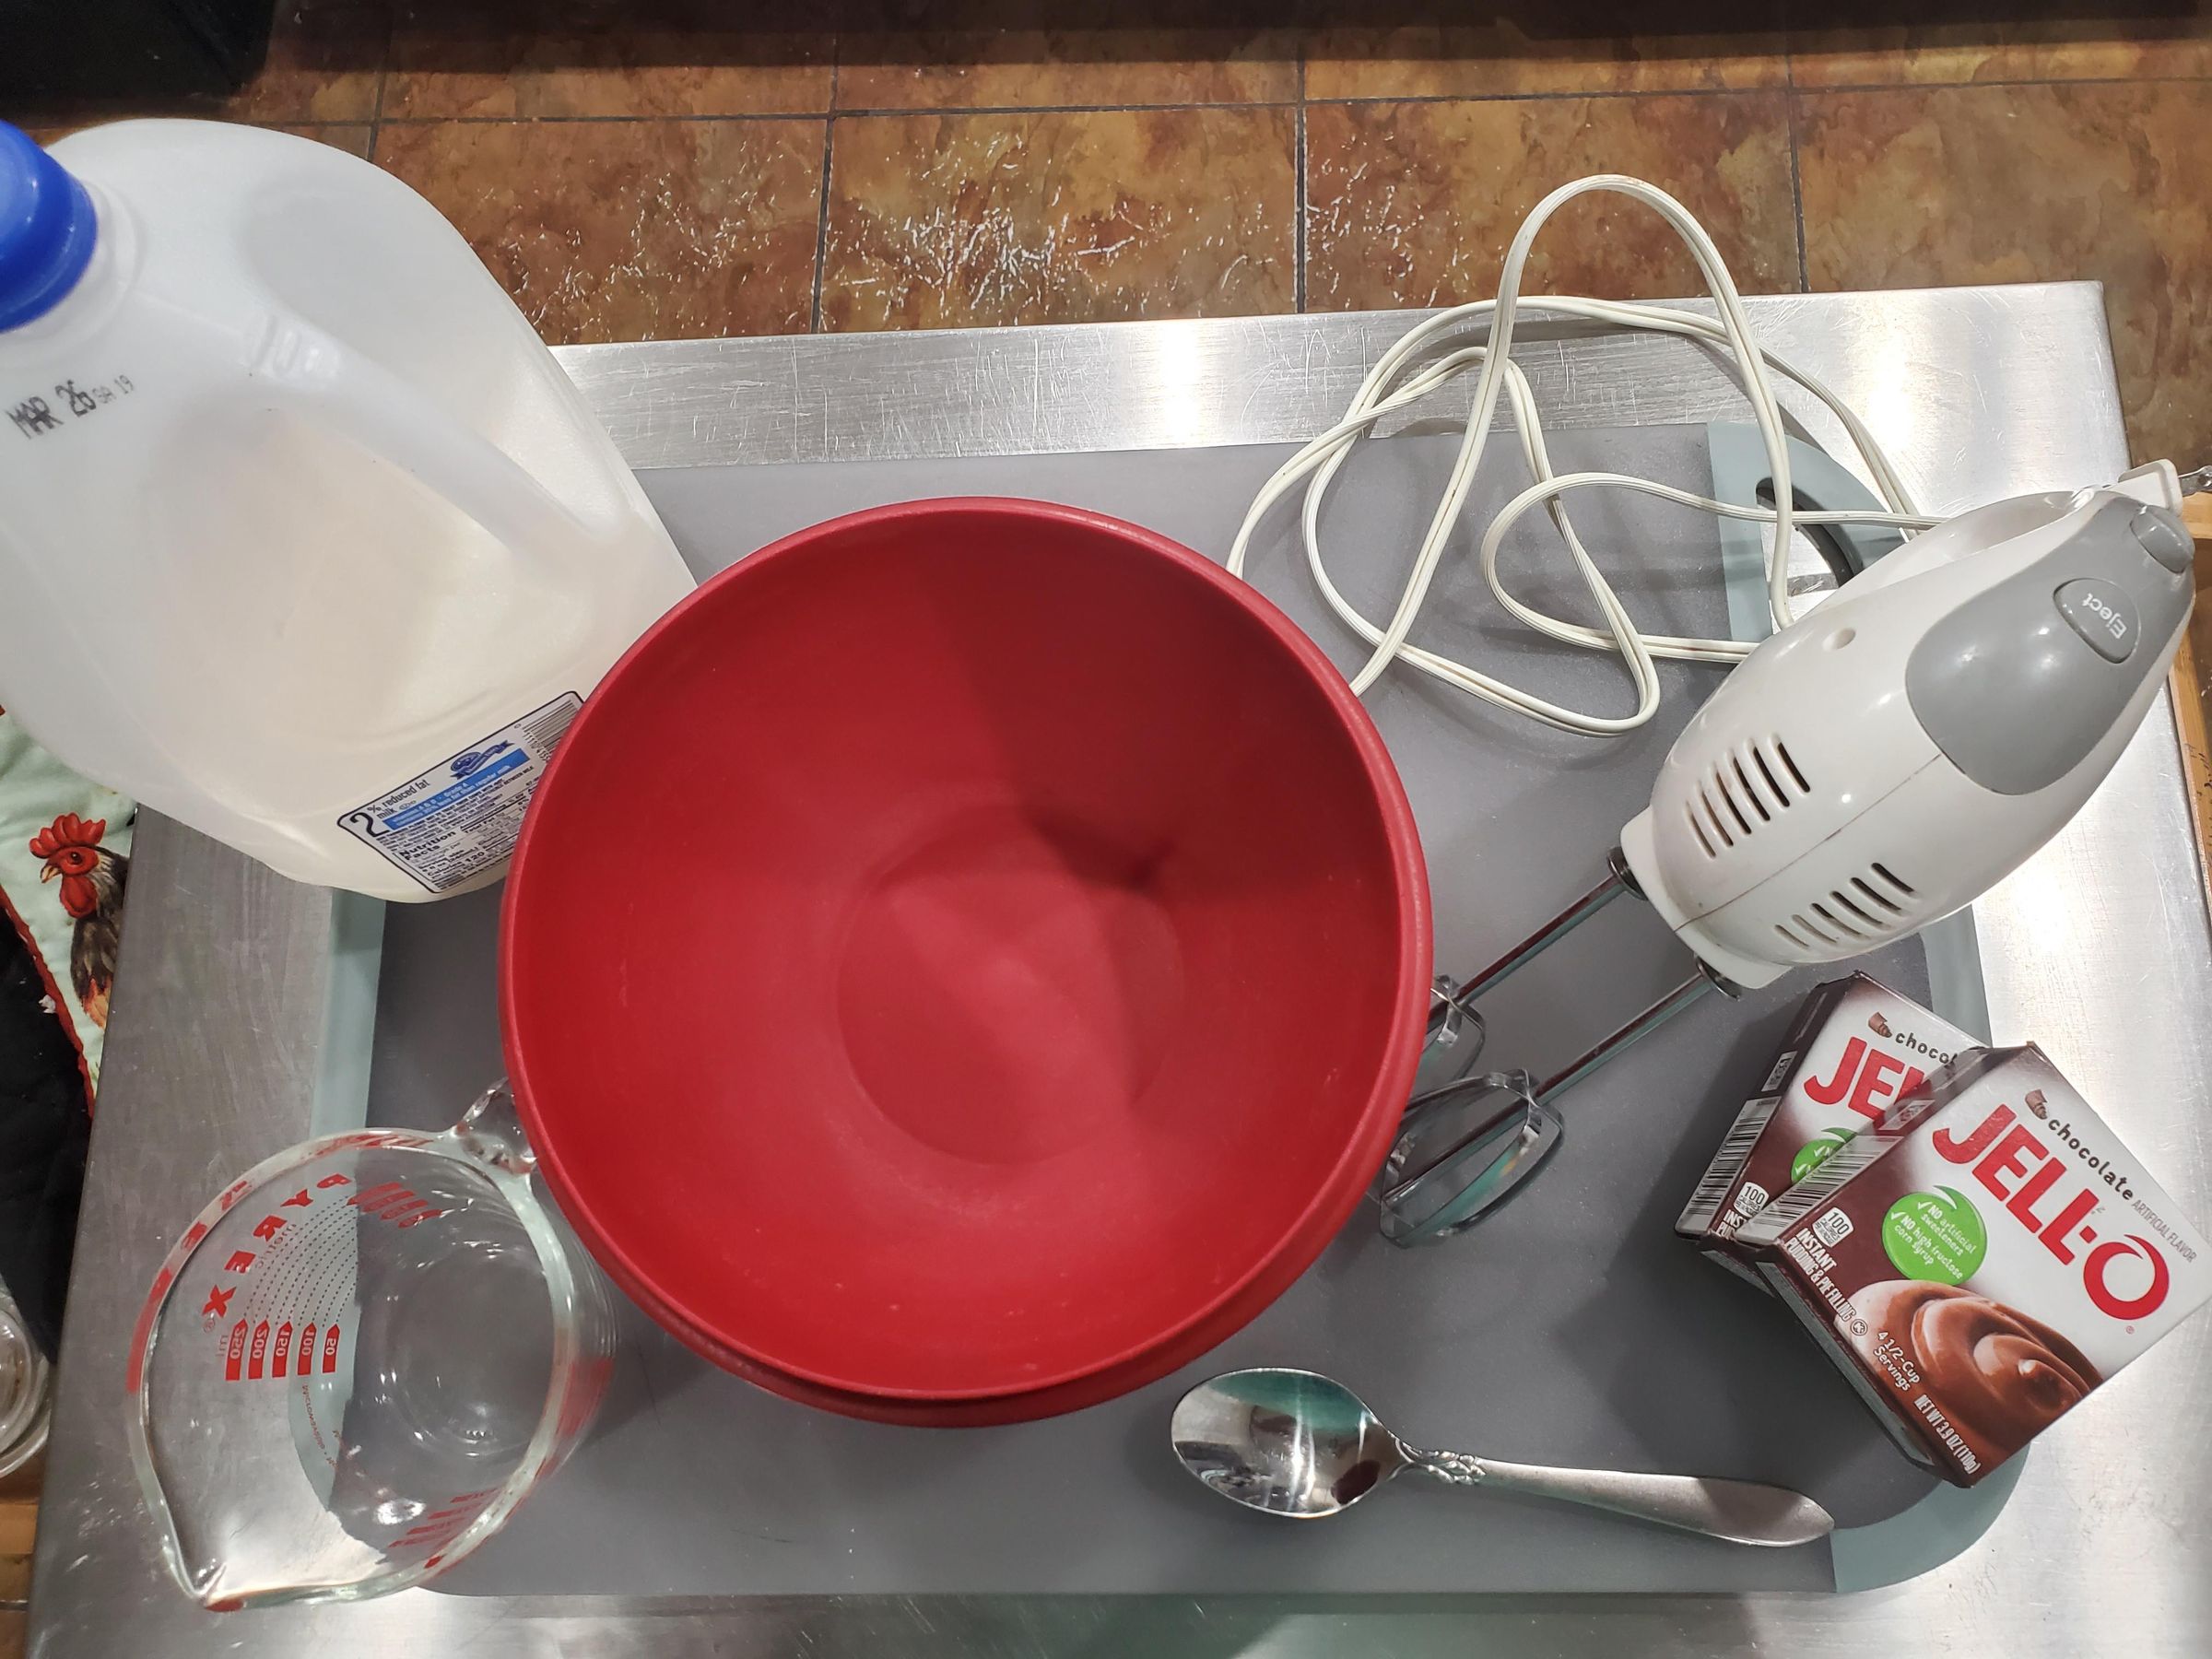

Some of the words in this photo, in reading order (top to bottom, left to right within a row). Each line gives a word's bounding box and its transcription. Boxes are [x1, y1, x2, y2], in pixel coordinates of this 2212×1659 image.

[54, 379, 96, 418] 26
[2082, 593, 2127, 639] Eject
[349, 812, 391, 838] 2
[382, 784, 418, 809] reduced
[416, 779, 431, 794] fat
[376, 806, 397, 820] milk
[401, 830, 455, 855] Nutrition
[405, 844, 441, 861] Facts
[1745, 1185, 1766, 1205] 100
[2048, 1118, 2135, 1200] chocolate
[2131, 1199, 2171, 1239] ARTIFICIAL
[2167, 1232, 2198, 1263] FLAVOR
[1828, 1211, 1851, 1234] 100
[1927, 1205, 1944, 1220] NO
[1940, 1219, 1977, 1253] artificial
[1932, 1103, 2171, 1321] JELL-O
[1795, 1227, 1838, 1273] INSTANT
[1894, 1224, 1913, 1244] corn
[1912, 1241, 1935, 1265] syrup
[1900, 1215, 1916, 1230] NO
[1912, 1227, 1933, 1248] high
[1932, 1245, 1964, 1279] fructose
[1921, 1214, 1964, 1256] sweeteners
[1784, 1236, 1820, 1277] PUDDING
[1810, 1269, 1825, 1284] &
[1816, 1276, 1835, 1296] PIE
[1825, 1288, 1857, 1323] FILLING
[1874, 1345, 1912, 1391] Servings
[1877, 1330, 1889, 1340] 4
[1884, 1338, 1921, 1384] 1/2-Cup
[1913, 1394, 1936, 1415] NET
[1925, 1407, 1947, 1428] WT
[1936, 1421, 1954, 1441] 3.9
[1946, 1434, 1964, 1452] OZ
[1953, 1441, 1982, 1475] (110g)
